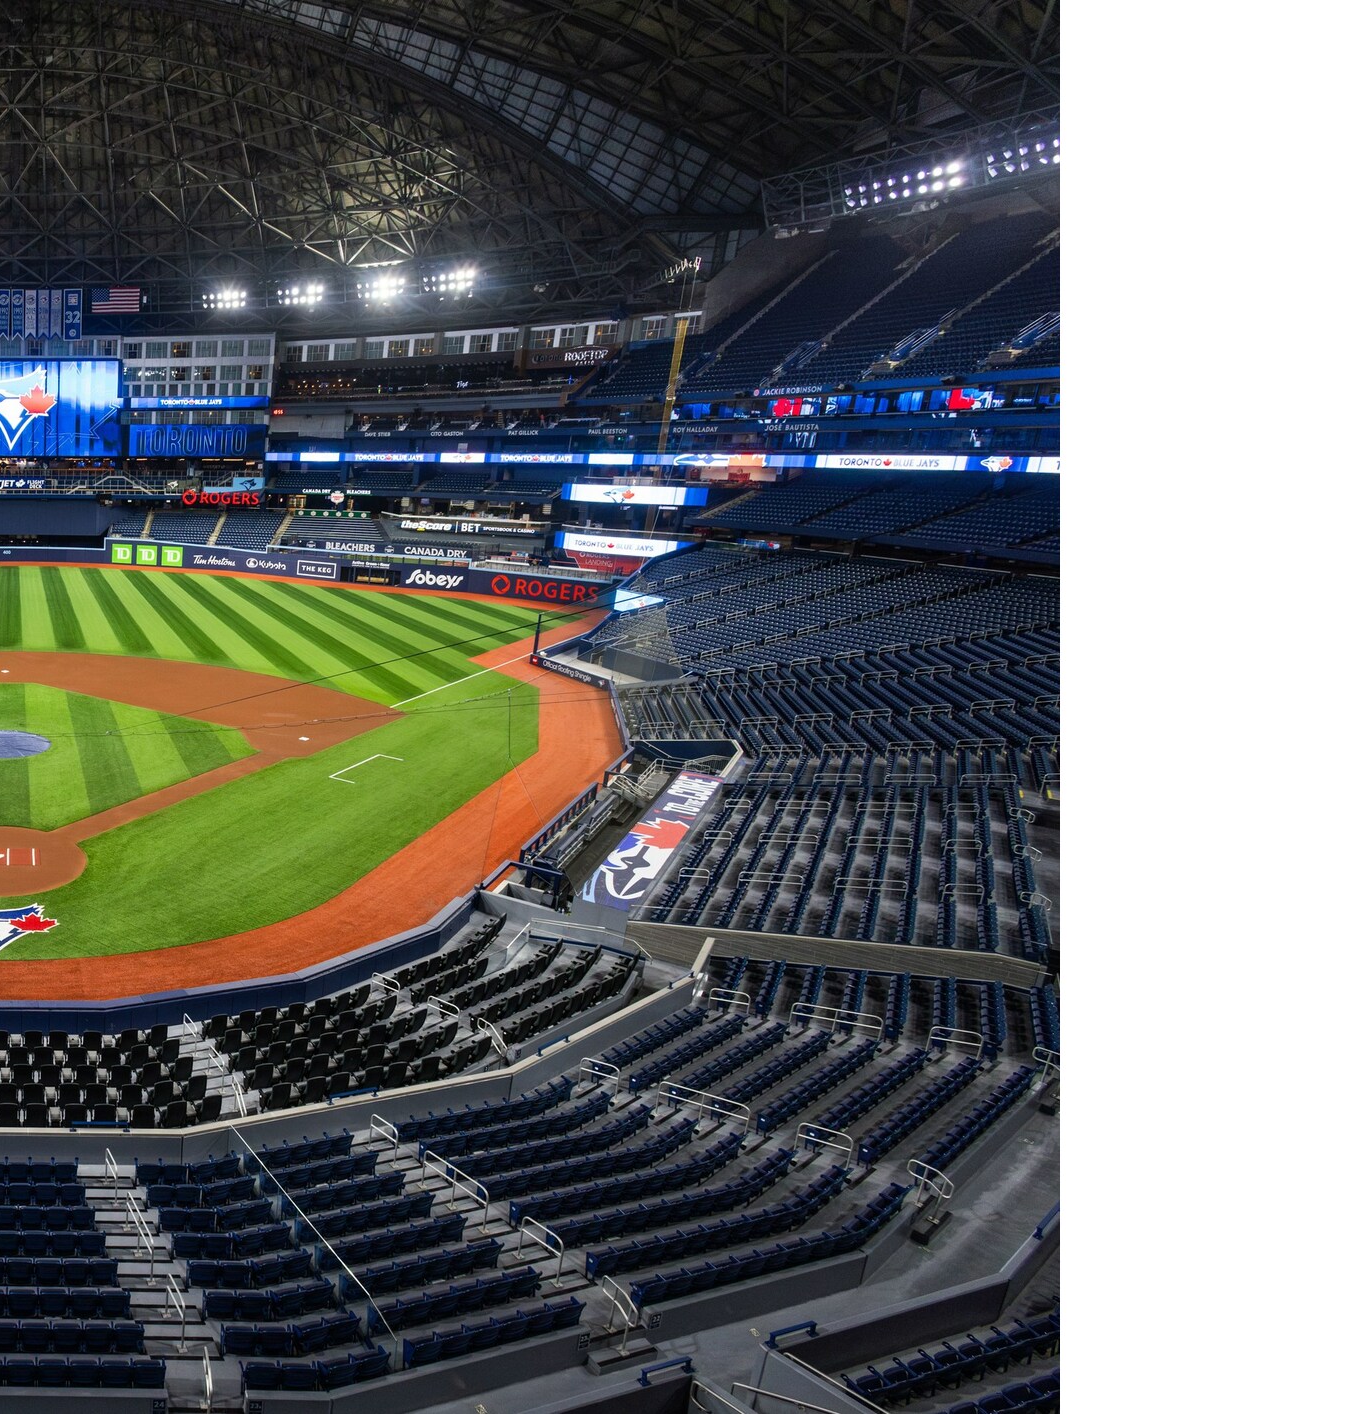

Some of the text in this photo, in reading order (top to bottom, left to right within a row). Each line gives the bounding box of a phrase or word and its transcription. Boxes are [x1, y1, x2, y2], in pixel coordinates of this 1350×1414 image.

[65, 311, 80, 323] 32
[564, 349, 608, 362] ROOFTOP
[762, 386, 822, 396] JACKIE ROBINSON
[138, 425, 248, 456] TORONTO
[840, 458, 940, 467] TORONTO BLUE JAYS
[200, 492, 259, 505] ROGERS
[401, 520, 452, 531] theScore
[461, 523, 481, 532] BET
[326, 542, 375, 552] BLEACHERS
[575, 540, 606, 548] TORONTO
[115, 547, 130, 559] TD
[139, 549, 154, 560] TD
[164, 550, 180, 562] TD
[404, 547, 445, 557] CANADA
[193, 555, 235, 566] Tim Hortons
[259, 560, 286, 570] Kubota
[585, 559, 614, 567] LANDING
[405, 569, 464, 588] Sobeys
[515, 578, 598, 603] ROGERS
[543, 660, 591, 682] Official Roofing Shingle
[667, 775, 720, 801] CORE
[663, 802, 700, 816] TO
